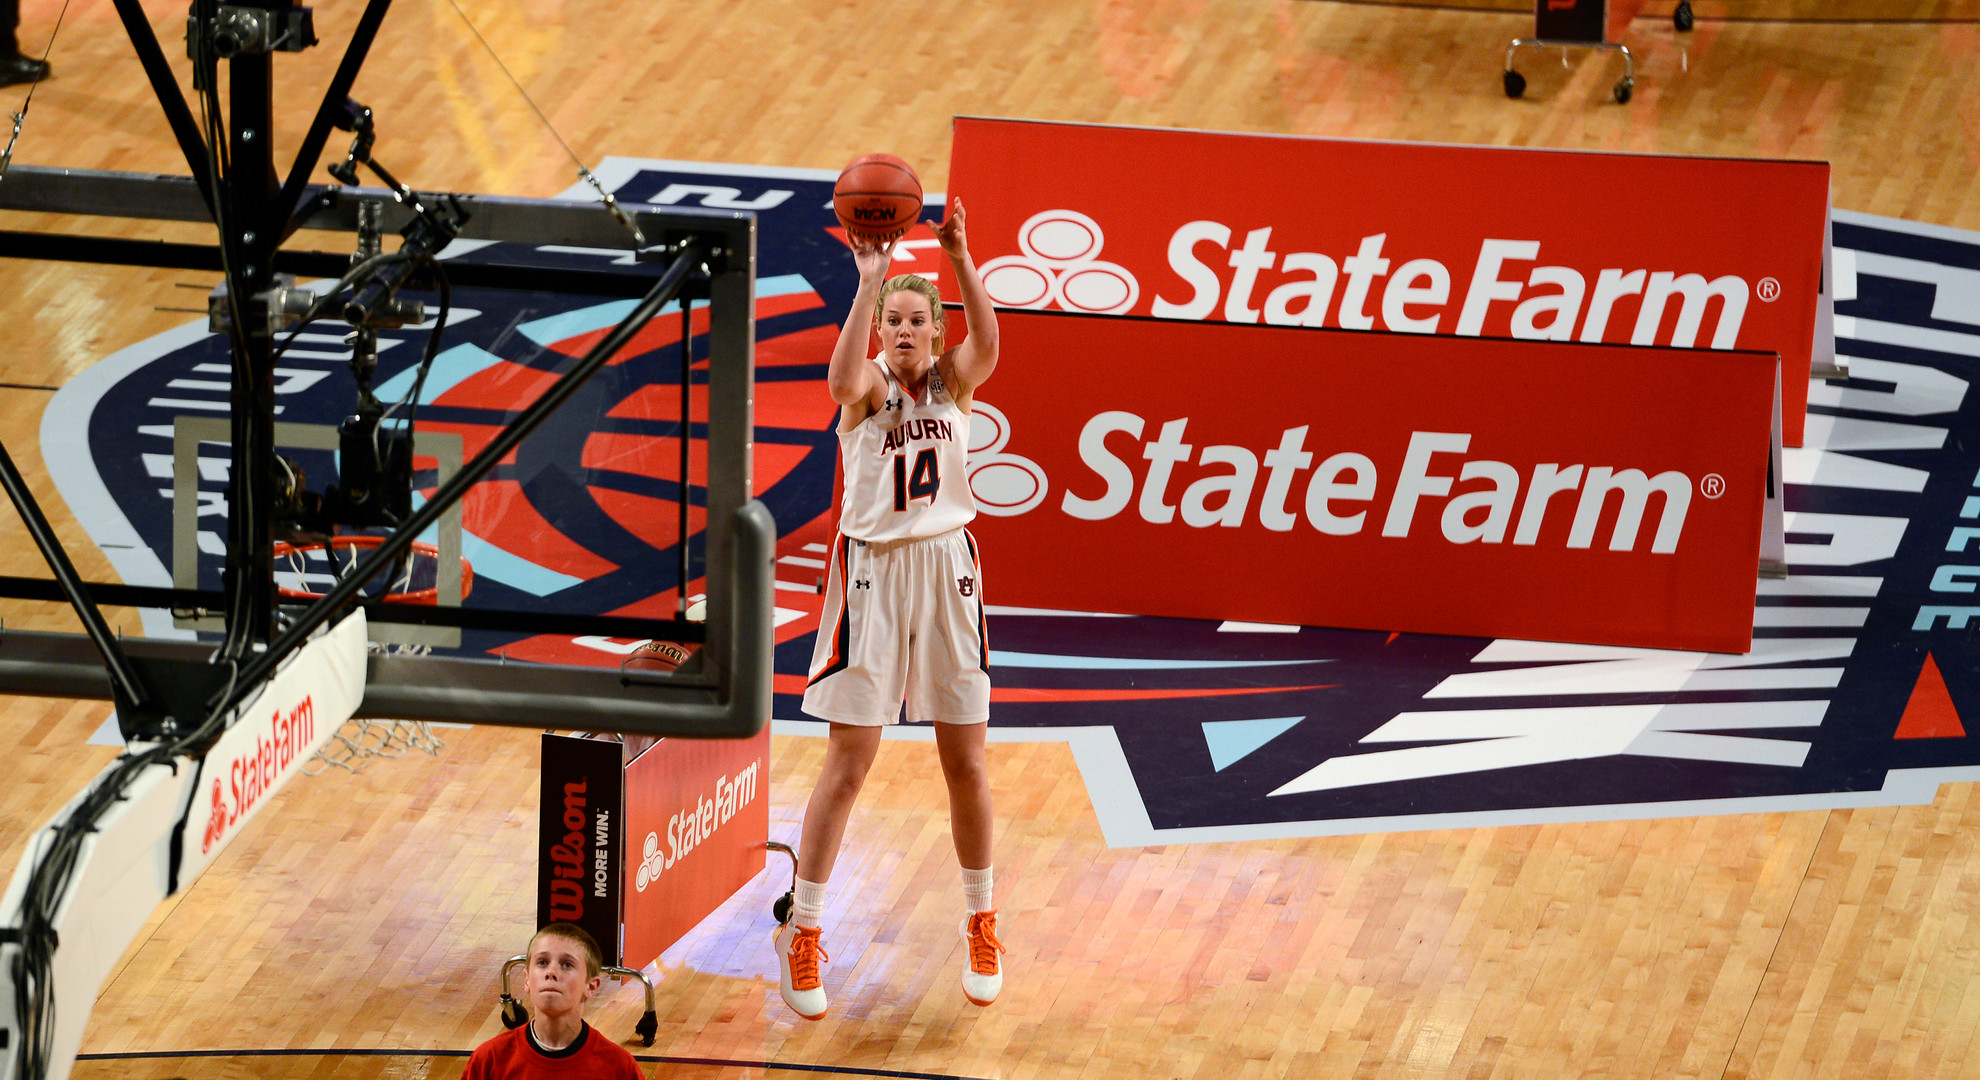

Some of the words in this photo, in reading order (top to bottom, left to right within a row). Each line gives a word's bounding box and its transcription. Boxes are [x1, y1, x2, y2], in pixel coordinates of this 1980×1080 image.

[853, 207, 897, 221] NCAA
[893, 446, 941, 512] 14
[550, 781, 588, 921] Wilson
[594, 850, 608, 898] MORE
